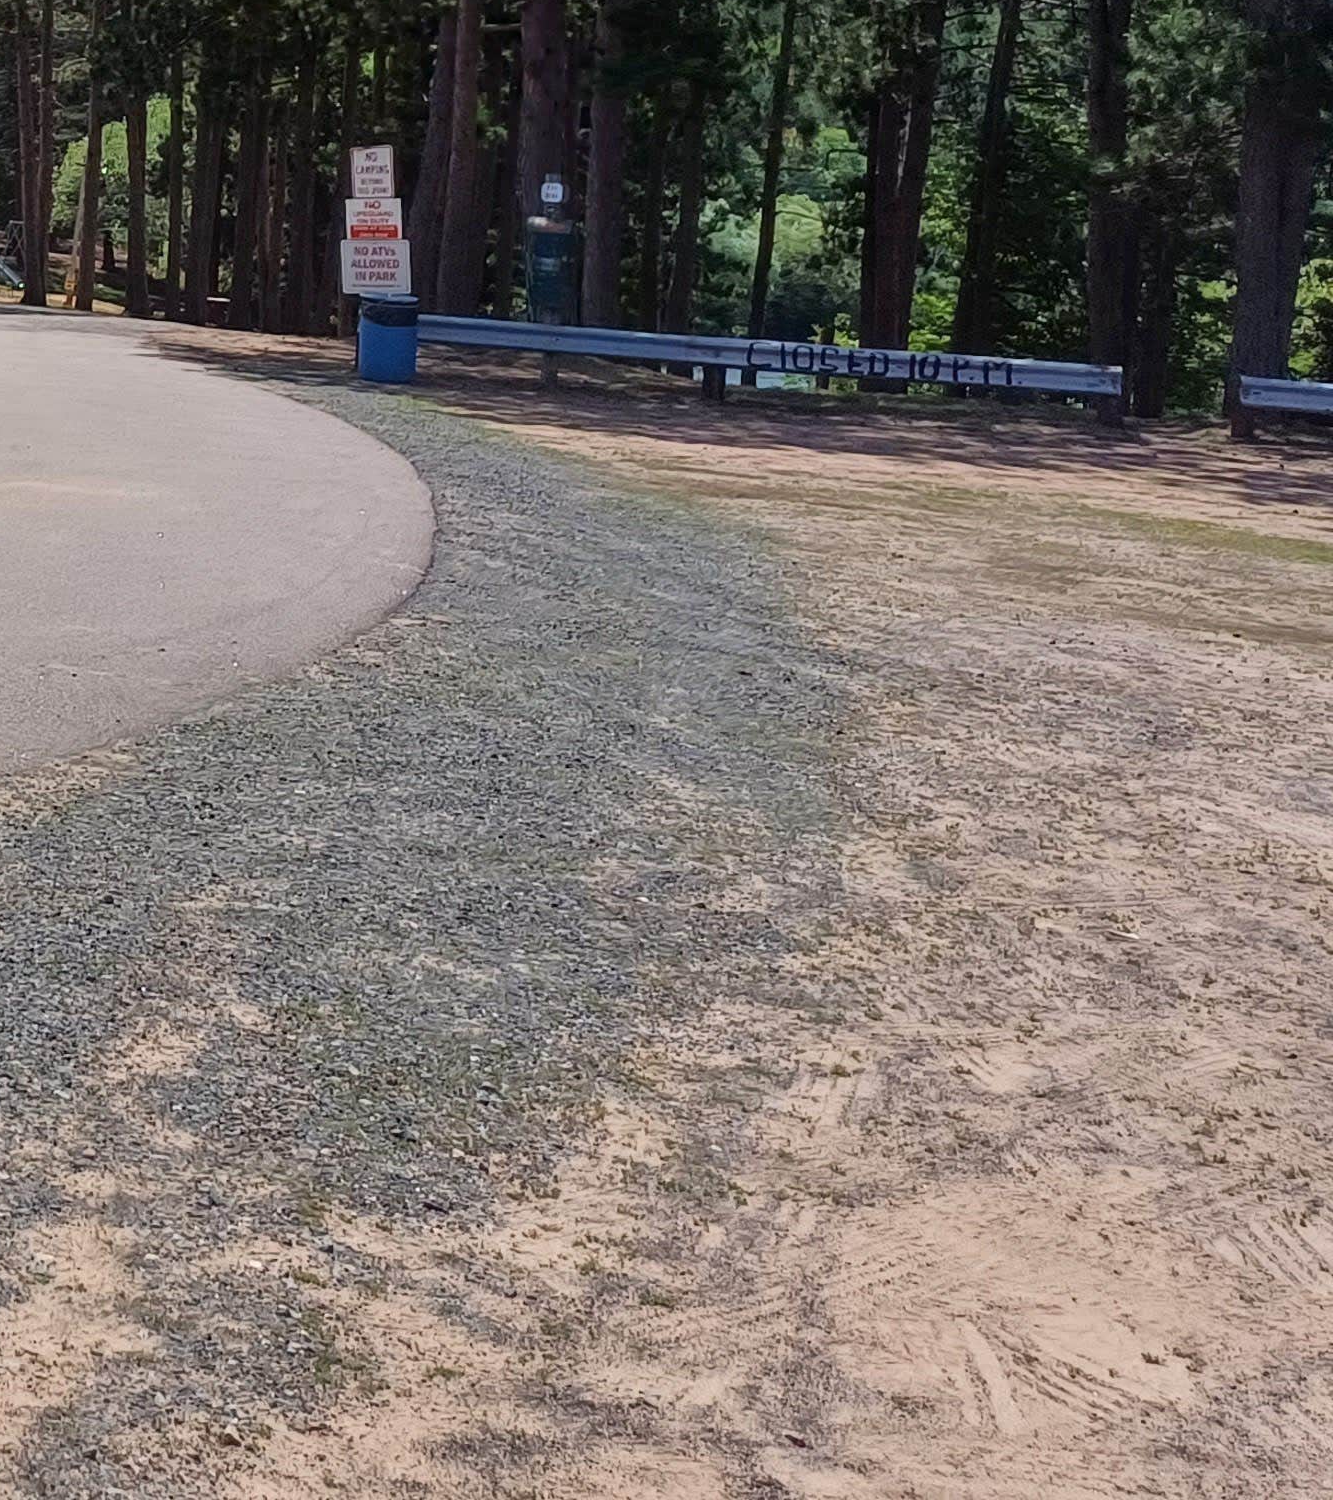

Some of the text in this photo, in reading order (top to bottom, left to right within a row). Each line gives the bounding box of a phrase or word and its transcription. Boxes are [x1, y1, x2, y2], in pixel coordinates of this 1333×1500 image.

[365, 152, 378, 162] NO
[356, 164, 389, 174] CAMPING
[364, 200, 381, 210] NO
[354, 246, 396, 256] NO ATVs
[351, 259, 400, 269] ALLOWED
[355, 271, 397, 281] IN PARK
